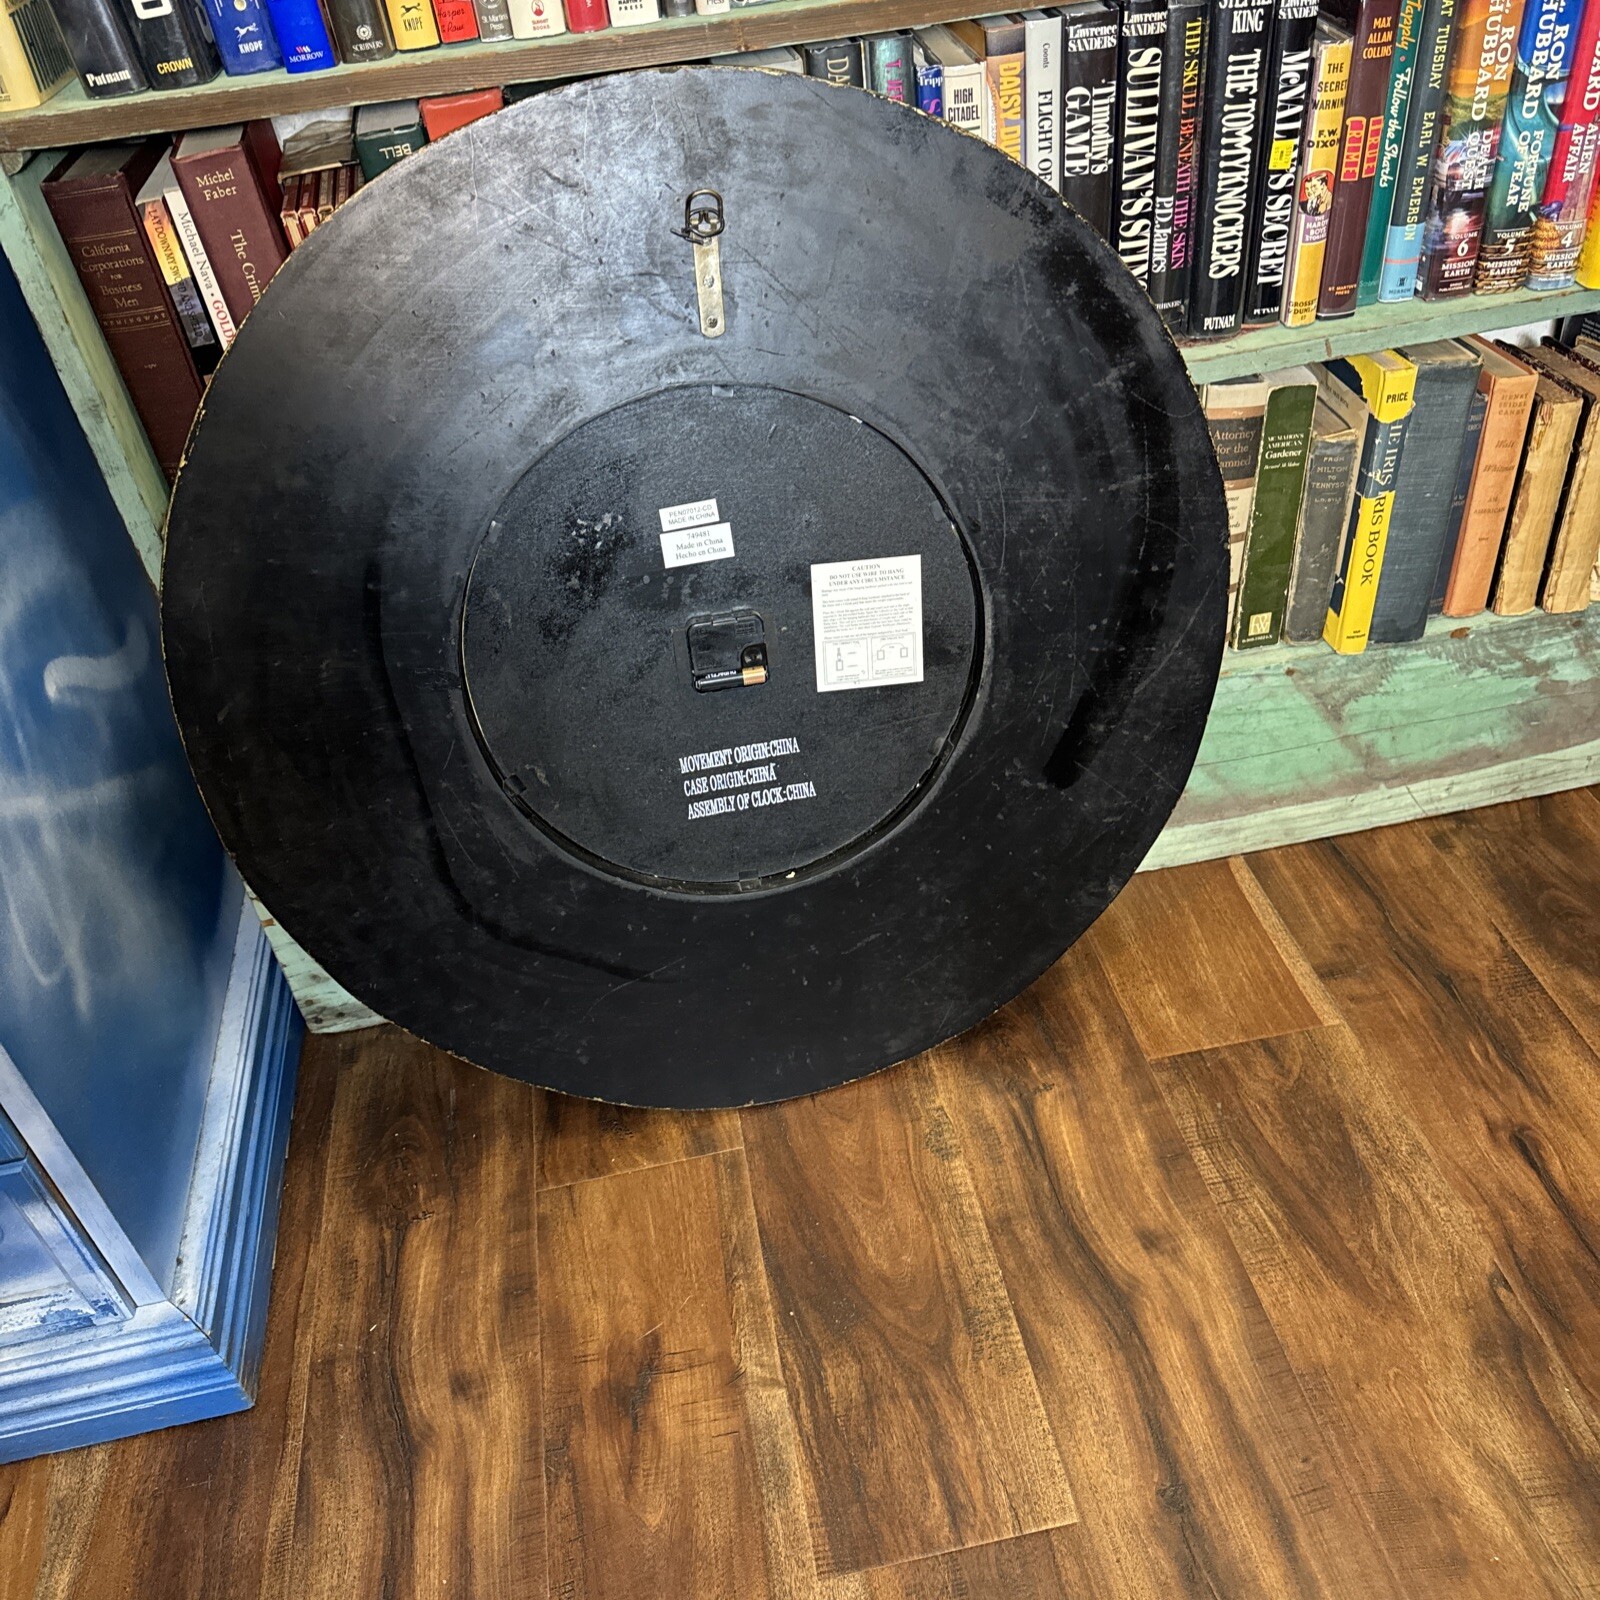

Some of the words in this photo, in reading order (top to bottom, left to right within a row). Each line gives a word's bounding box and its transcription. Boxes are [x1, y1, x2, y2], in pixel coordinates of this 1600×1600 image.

[438, 9, 465, 19] Harper
[1123, 10, 1168, 24] Lawrence
[1231, 8, 1264, 34] KING
[1373, 16, 1392, 29] MAX
[403, 17, 423, 31] KNOPF
[490, 23, 505, 31] Press
[1068, 24, 1117, 39] Lawrence
[1122, 21, 1168, 37] SANDERS
[1068, 35, 1117, 52] SANDERS
[1184, 17, 1202, 57] THE
[1367, 31, 1393, 44] ALLAN
[238, 40, 263, 54] KNOPF
[1042, 42, 1050, 69] Coonts
[1362, 45, 1392, 59] COLLINS
[1493, 25, 1515, 80] RON
[1545, 23, 1570, 81] RON
[156, 57, 193, 75] CROWN
[289, 51, 323, 63] MORROW
[1429, 25, 1450, 90] TUESDAY
[1471, 0, 1504, 121] HUBBARD
[1521, 0, 1560, 119] HUBBARD
[1225, 48, 1261, 98] THE
[1327, 62, 1345, 74] THE
[85, 69, 131, 87] Putnam
[920, 74, 943, 88] Tripp
[1181, 59, 1199, 114] SKULL
[1317, 79, 1348, 92] SECRET
[953, 87, 973, 105] HIGH
[1000, 61, 1021, 120] DAISY
[1390, 67, 1411, 118] Follow
[948, 104, 980, 123] CITADEL
[1037, 89, 1053, 152] FLIGHT
[1065, 86, 1091, 177] GAME
[1091, 78, 1116, 175] Timothy's
[1120, 47, 1162, 216] SULLIVAN'S
[1386, 118, 1402, 140] the
[1419, 111, 1436, 148] EARL
[379, 143, 412, 159] BELL
[1341, 116, 1367, 181] CRIME
[1362, 115, 1384, 178] TRUE
[1516, 131, 1531, 156] OF
[1562, 122, 1586, 183] AFFAIR
[1579, 122, 1599, 175] ALIEN
[1176, 117, 1195, 193] BENEATH
[1379, 139, 1399, 188] Sharks
[1461, 131, 1480, 190] QUEST
[1474, 129, 1494, 190] DEATH
[195, 167, 235, 187] Michel
[1518, 129, 1545, 214] FORTUNE
[1208, 98, 1257, 279] TOMMYKNOCKERS
[1506, 161, 1526, 207] FEAR
[203, 186, 237, 201] Faber
[1174, 195, 1190, 231] THE
[1404, 176, 1424, 240] EMERSON
[1257, 193, 1293, 287] SECRET
[1450, 231, 1478, 240] VOLUME
[1496, 231, 1525, 239] VOLUME
[1560, 231, 1574, 247] 4
[82, 243, 130, 258] California
[178, 212, 201, 257] Michael
[197, 258, 213, 289] Nava
[230, 229, 247, 260] The
[1171, 232, 1186, 270] SKIN
[1457, 239, 1469, 257] 6
[1503, 238, 1516, 256] 5
[1441, 260, 1476, 271] MISSION
[1486, 259, 1523, 269] MISSION
[1543, 251, 1579, 262] MISSION
[1546, 260, 1575, 269] EARTH
[80, 256, 144, 276] Corporations
[1444, 268, 1470, 278] EARTH
[1489, 267, 1517, 276] EARTH
[100, 282, 142, 296] Business
[1335, 288, 1350, 296] PRESS
[114, 297, 139, 309] Men
[1254, 305, 1279, 315] PUTNAM
[1203, 313, 1236, 330] PUTNAM
[1386, 392, 1408, 403] PRICE
[1214, 429, 1255, 441] Attorney
[1495, 439, 1516, 449] Walt
[1216, 444, 1230, 455] for
[1233, 443, 1249, 454] the
[1265, 449, 1302, 459] Gardener
[1316, 465, 1347, 473] MILTON
[1380, 448, 1398, 486] IRIS
[668, 517, 687, 526] MADE
[695, 511, 716, 520] CHINA
[1473, 506, 1505, 514] AMERICAN
[686, 529, 711, 540] 749481
[675, 551, 697, 560] Hecho
[707, 545, 727, 554] China
[676, 541, 695, 551] Made
[703, 537, 723, 546] China
[1360, 530, 1381, 586] BOOK
[861, 574, 905, 583] CIRCUMSTANCE
[679, 748, 733, 774] MOVEMENT
[683, 776, 709, 797] CASE
[688, 795, 736, 820] ASSEMBLY
[736, 792, 750, 811] OF
